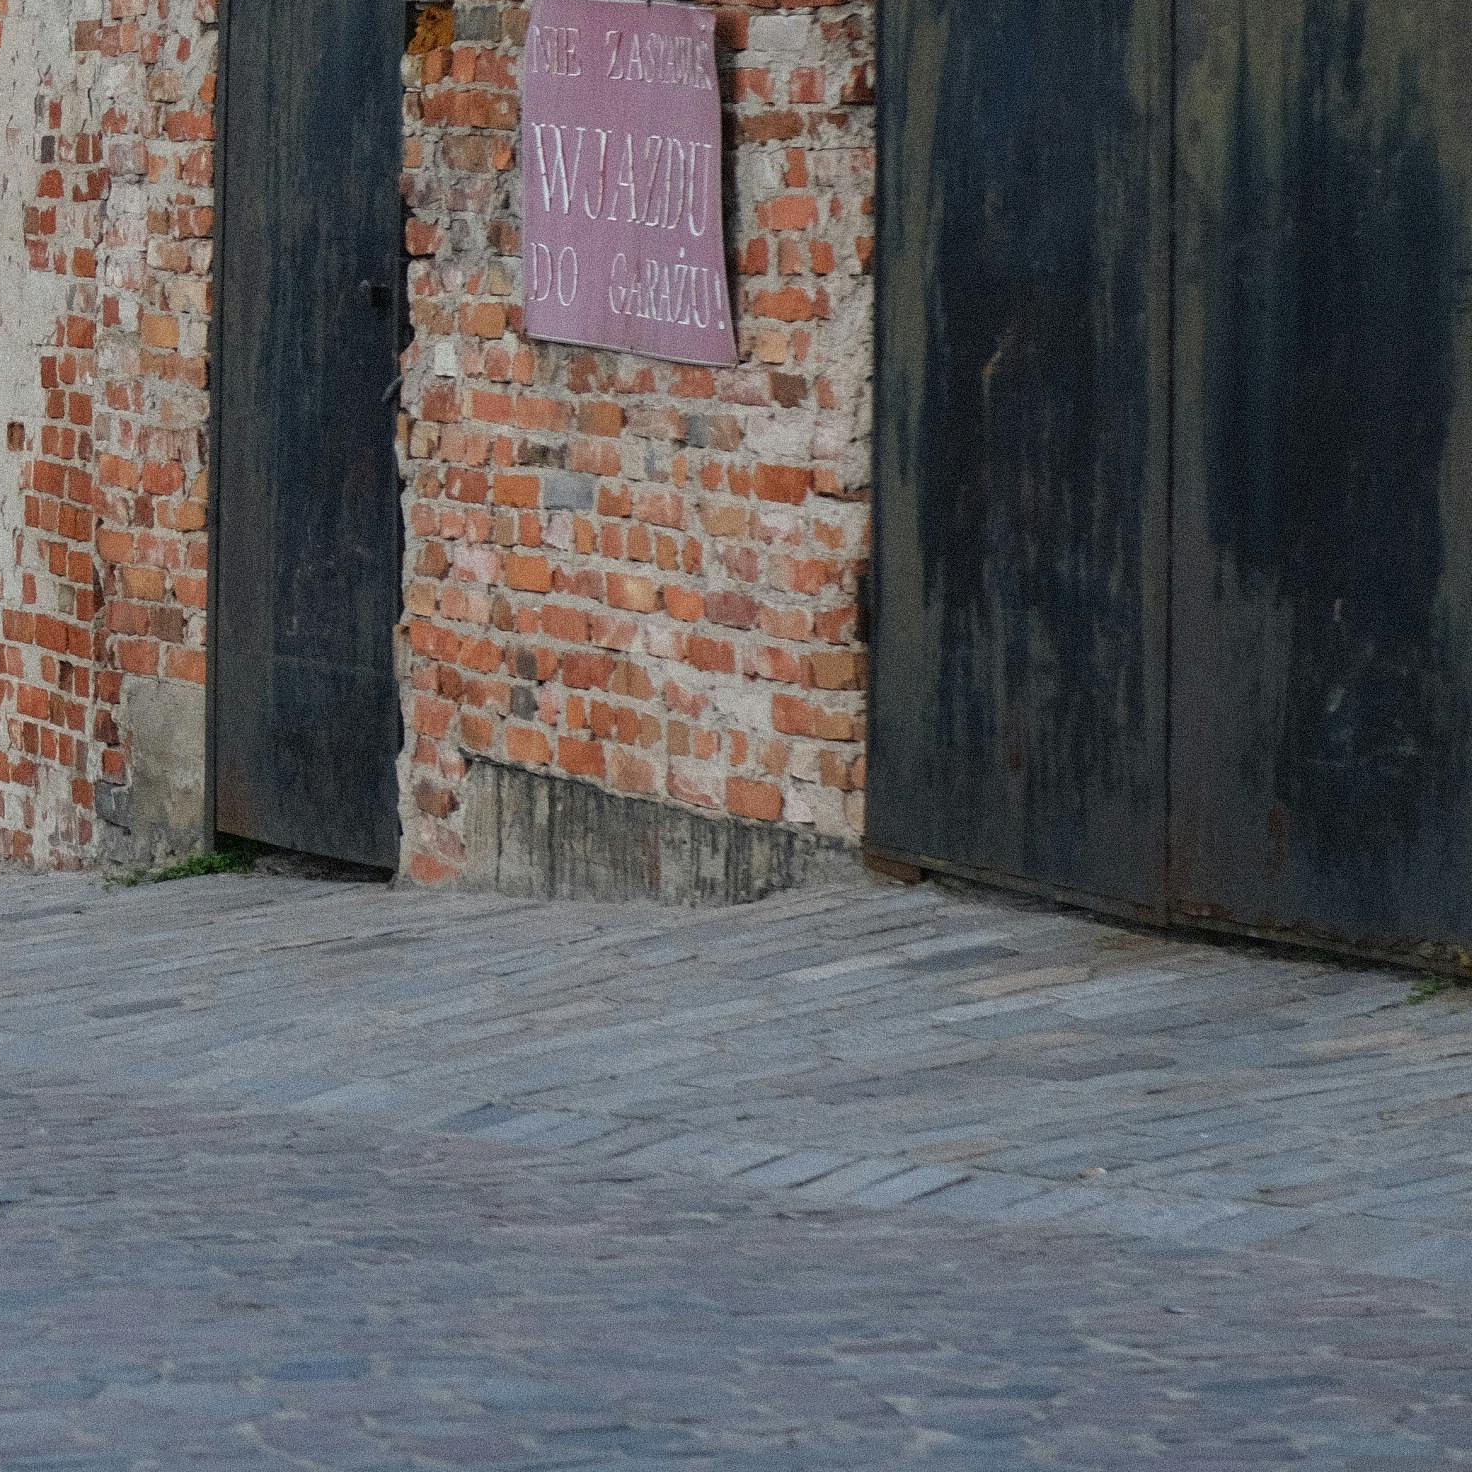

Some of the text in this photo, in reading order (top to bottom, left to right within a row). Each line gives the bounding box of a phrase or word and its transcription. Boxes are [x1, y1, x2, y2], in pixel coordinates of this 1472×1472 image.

[529, 26, 582, 77] NIE
[531, 122, 713, 237] WJAZDU
[529, 242, 579, 307] DO
